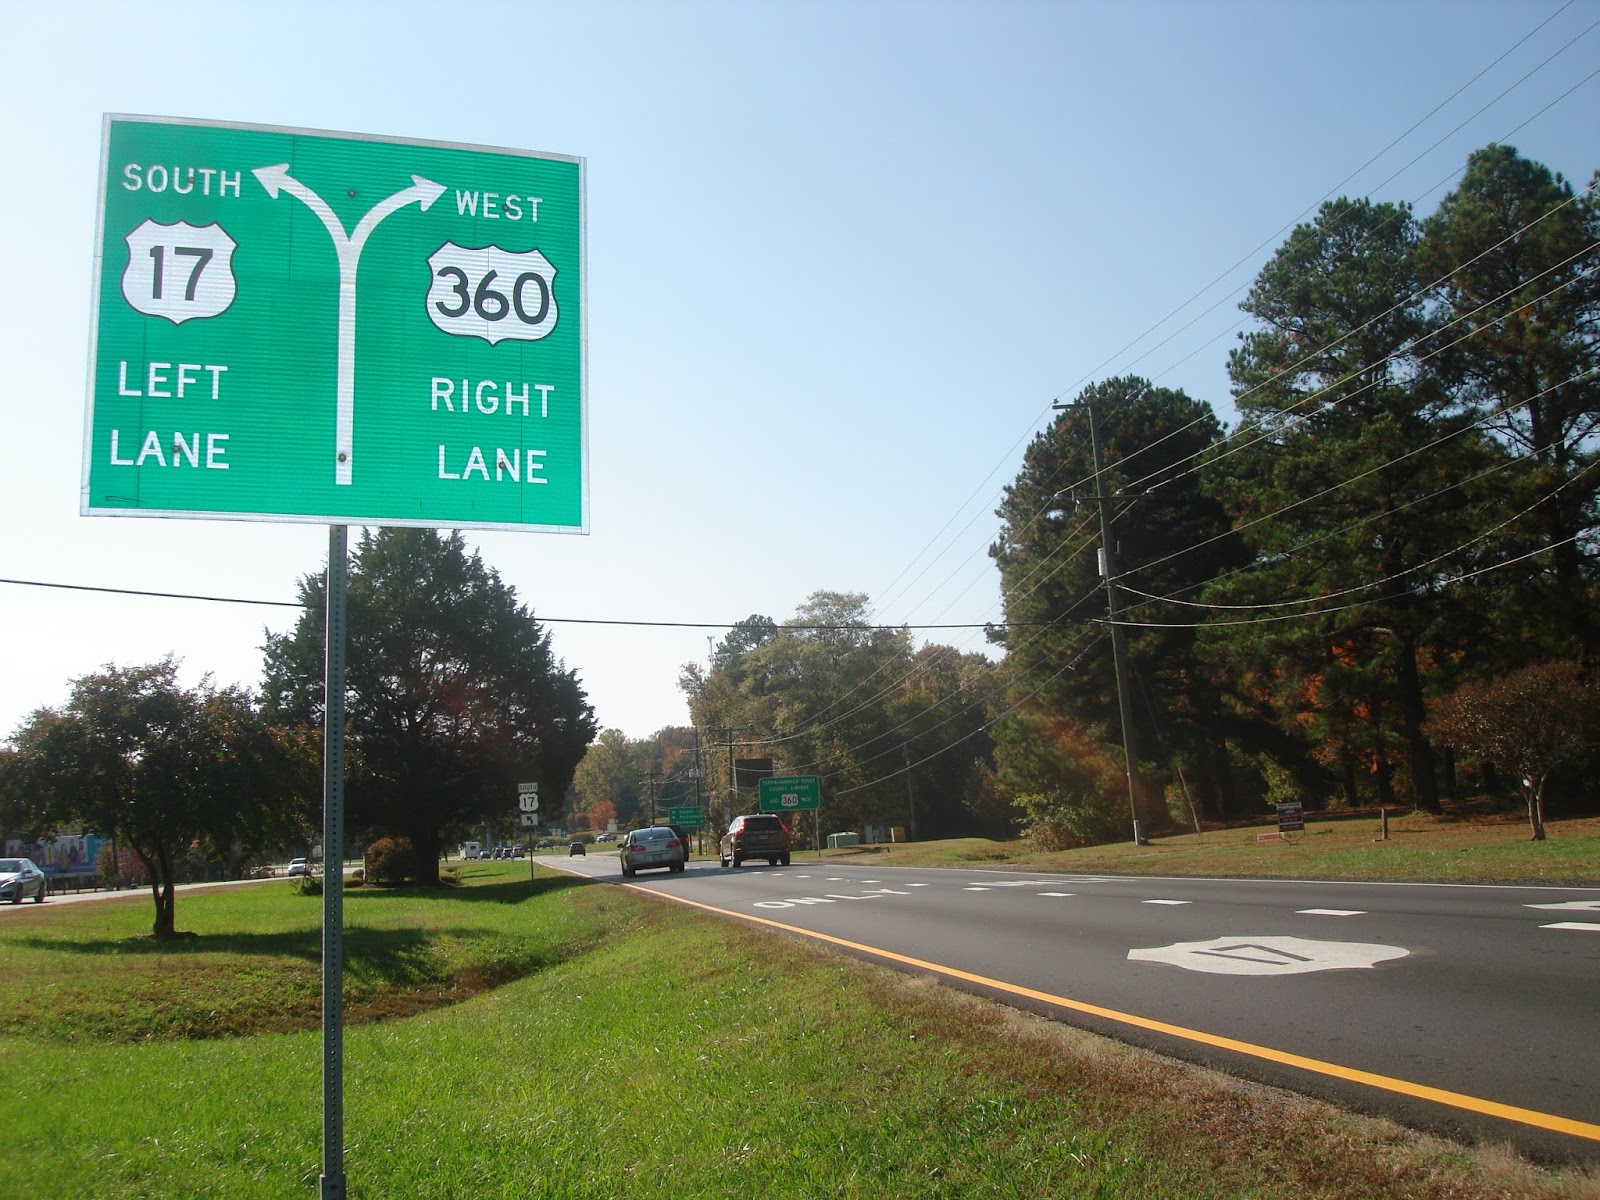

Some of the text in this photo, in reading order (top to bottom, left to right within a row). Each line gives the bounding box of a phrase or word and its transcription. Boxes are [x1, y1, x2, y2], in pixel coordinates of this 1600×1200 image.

[122, 163, 241, 198] SOUTH
[455, 190, 544, 224] WEST
[149, 245, 214, 302] 17
[435, 266, 551, 325] 360
[118, 361, 228, 400] LEFT
[430, 377, 555, 418] RIGHT
[110, 429, 230, 470] LANE
[437, 444, 549, 485] LANE
[523, 797, 535, 808] 17
[753, 889, 911, 908] ONLY
